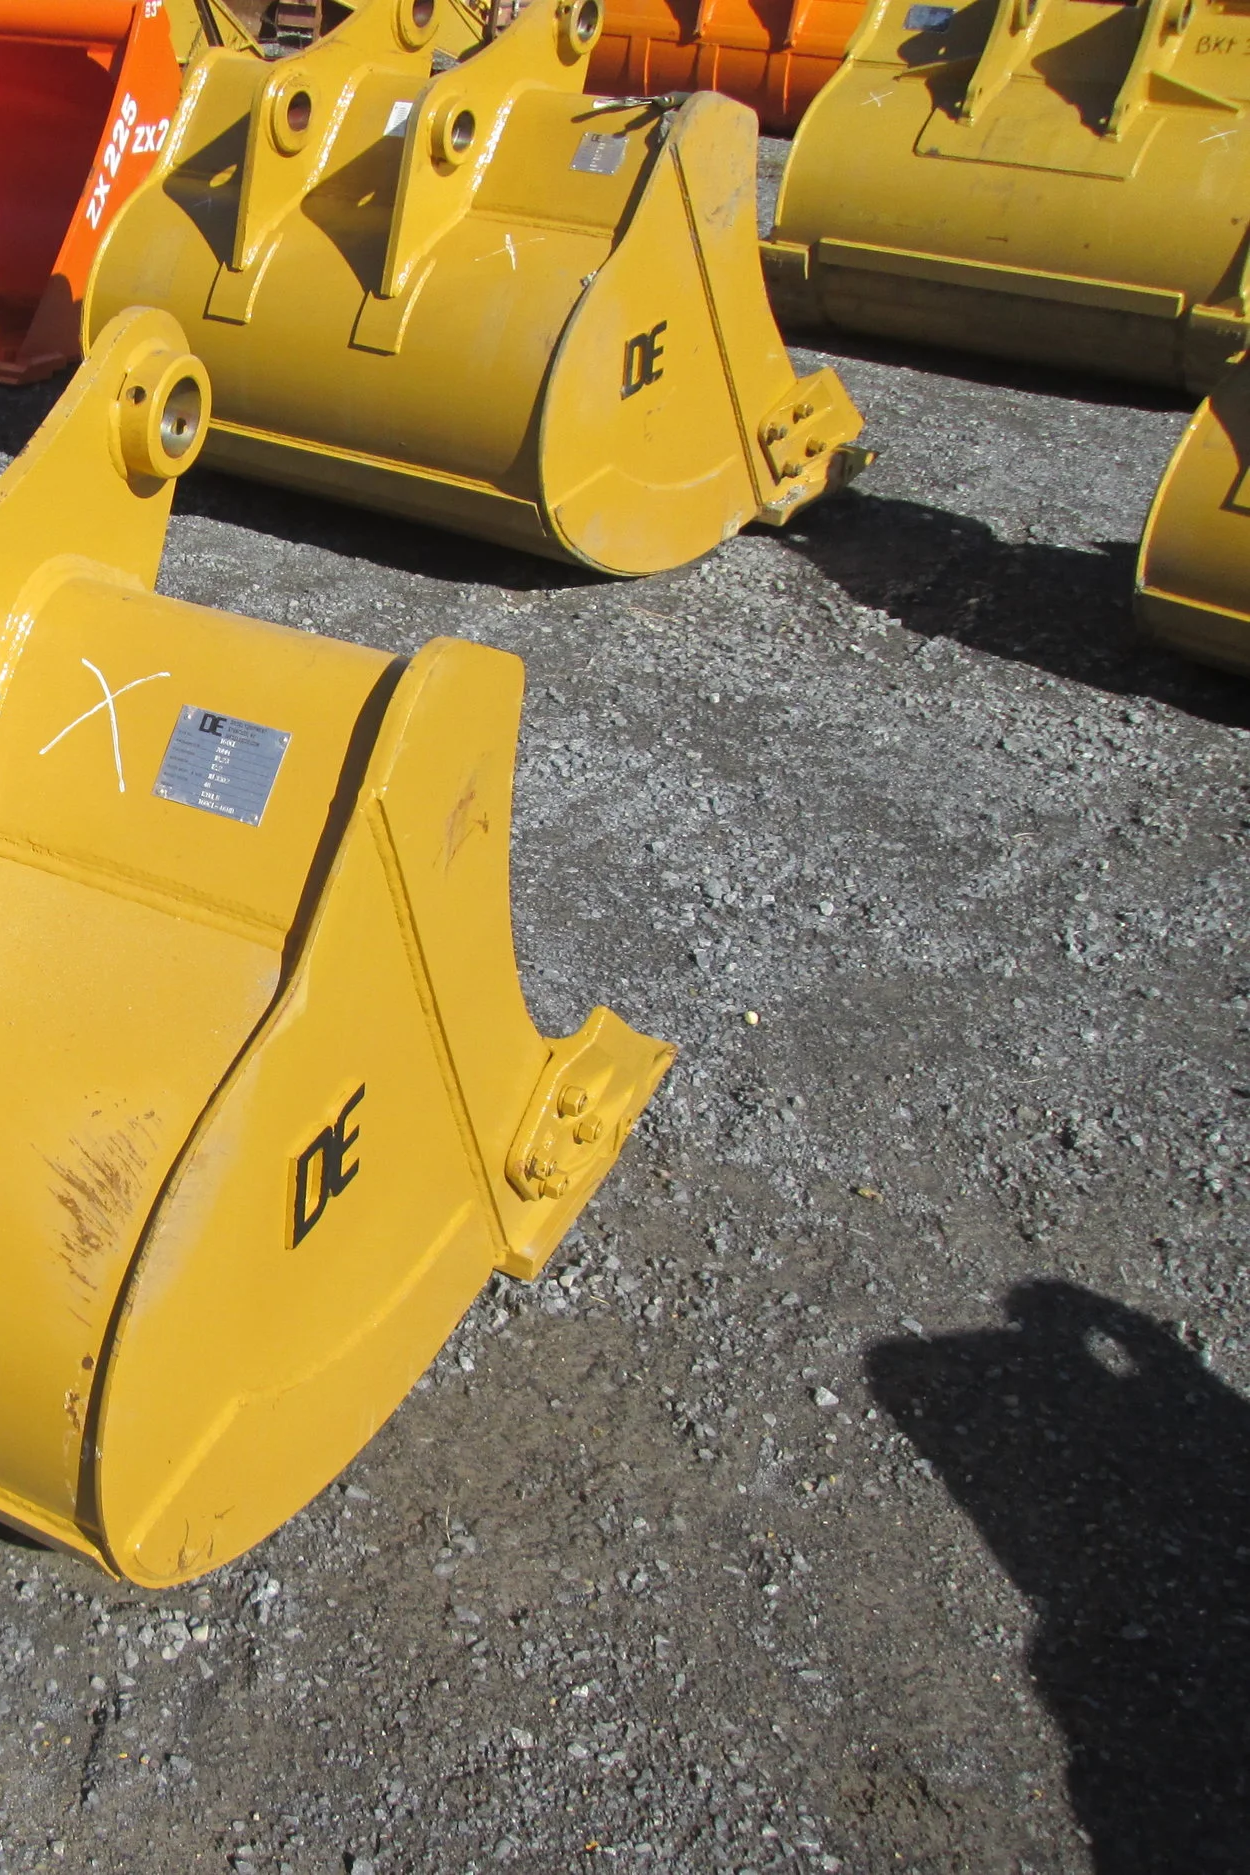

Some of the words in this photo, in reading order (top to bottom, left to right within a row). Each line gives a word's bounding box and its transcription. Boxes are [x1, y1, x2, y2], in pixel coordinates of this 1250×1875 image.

[85, 172, 111, 231] ZX
[103, 92, 138, 178] 225
[619, 319, 668, 401] DE
[199, 713, 227, 736] DE
[286, 1081, 366, 1251] DE
